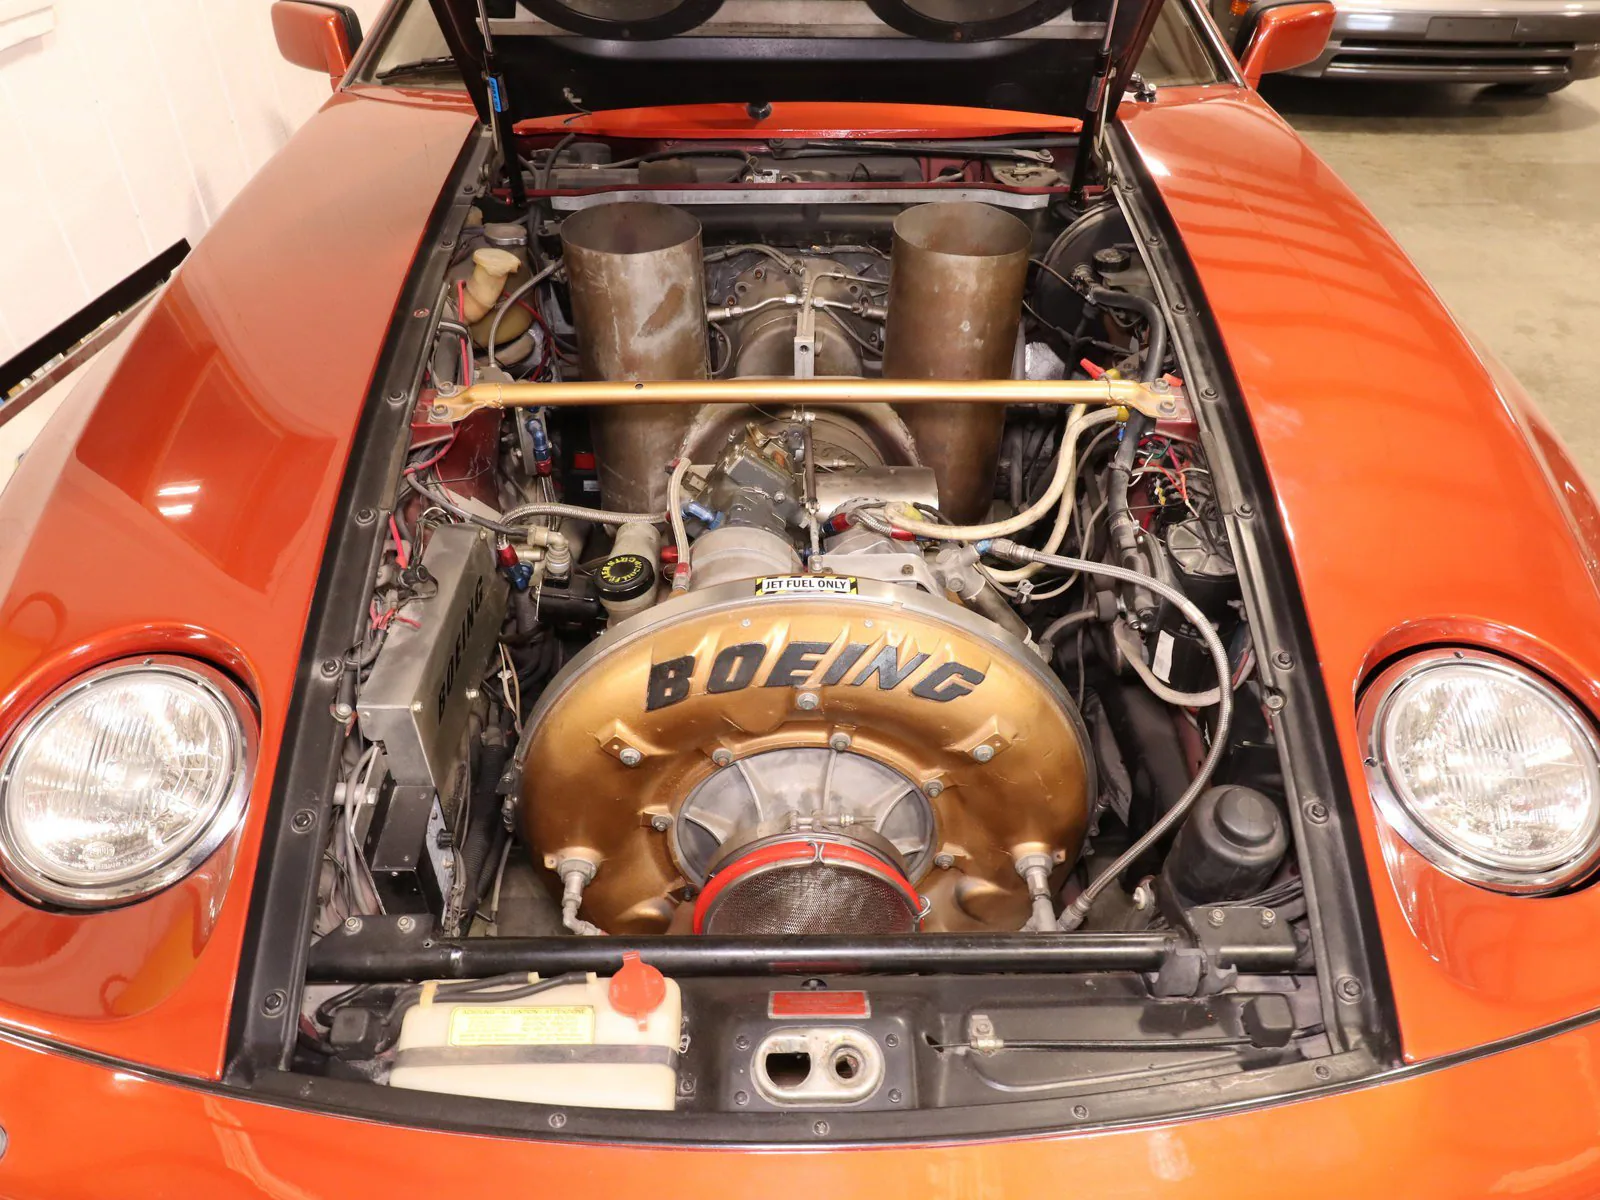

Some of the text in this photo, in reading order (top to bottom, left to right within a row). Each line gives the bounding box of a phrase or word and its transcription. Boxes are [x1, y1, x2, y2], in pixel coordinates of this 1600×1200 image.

[766, 579, 847, 589] JET FUEL ONLY
[438, 575, 483, 725] BOEING
[645, 640, 986, 713] BOEING
